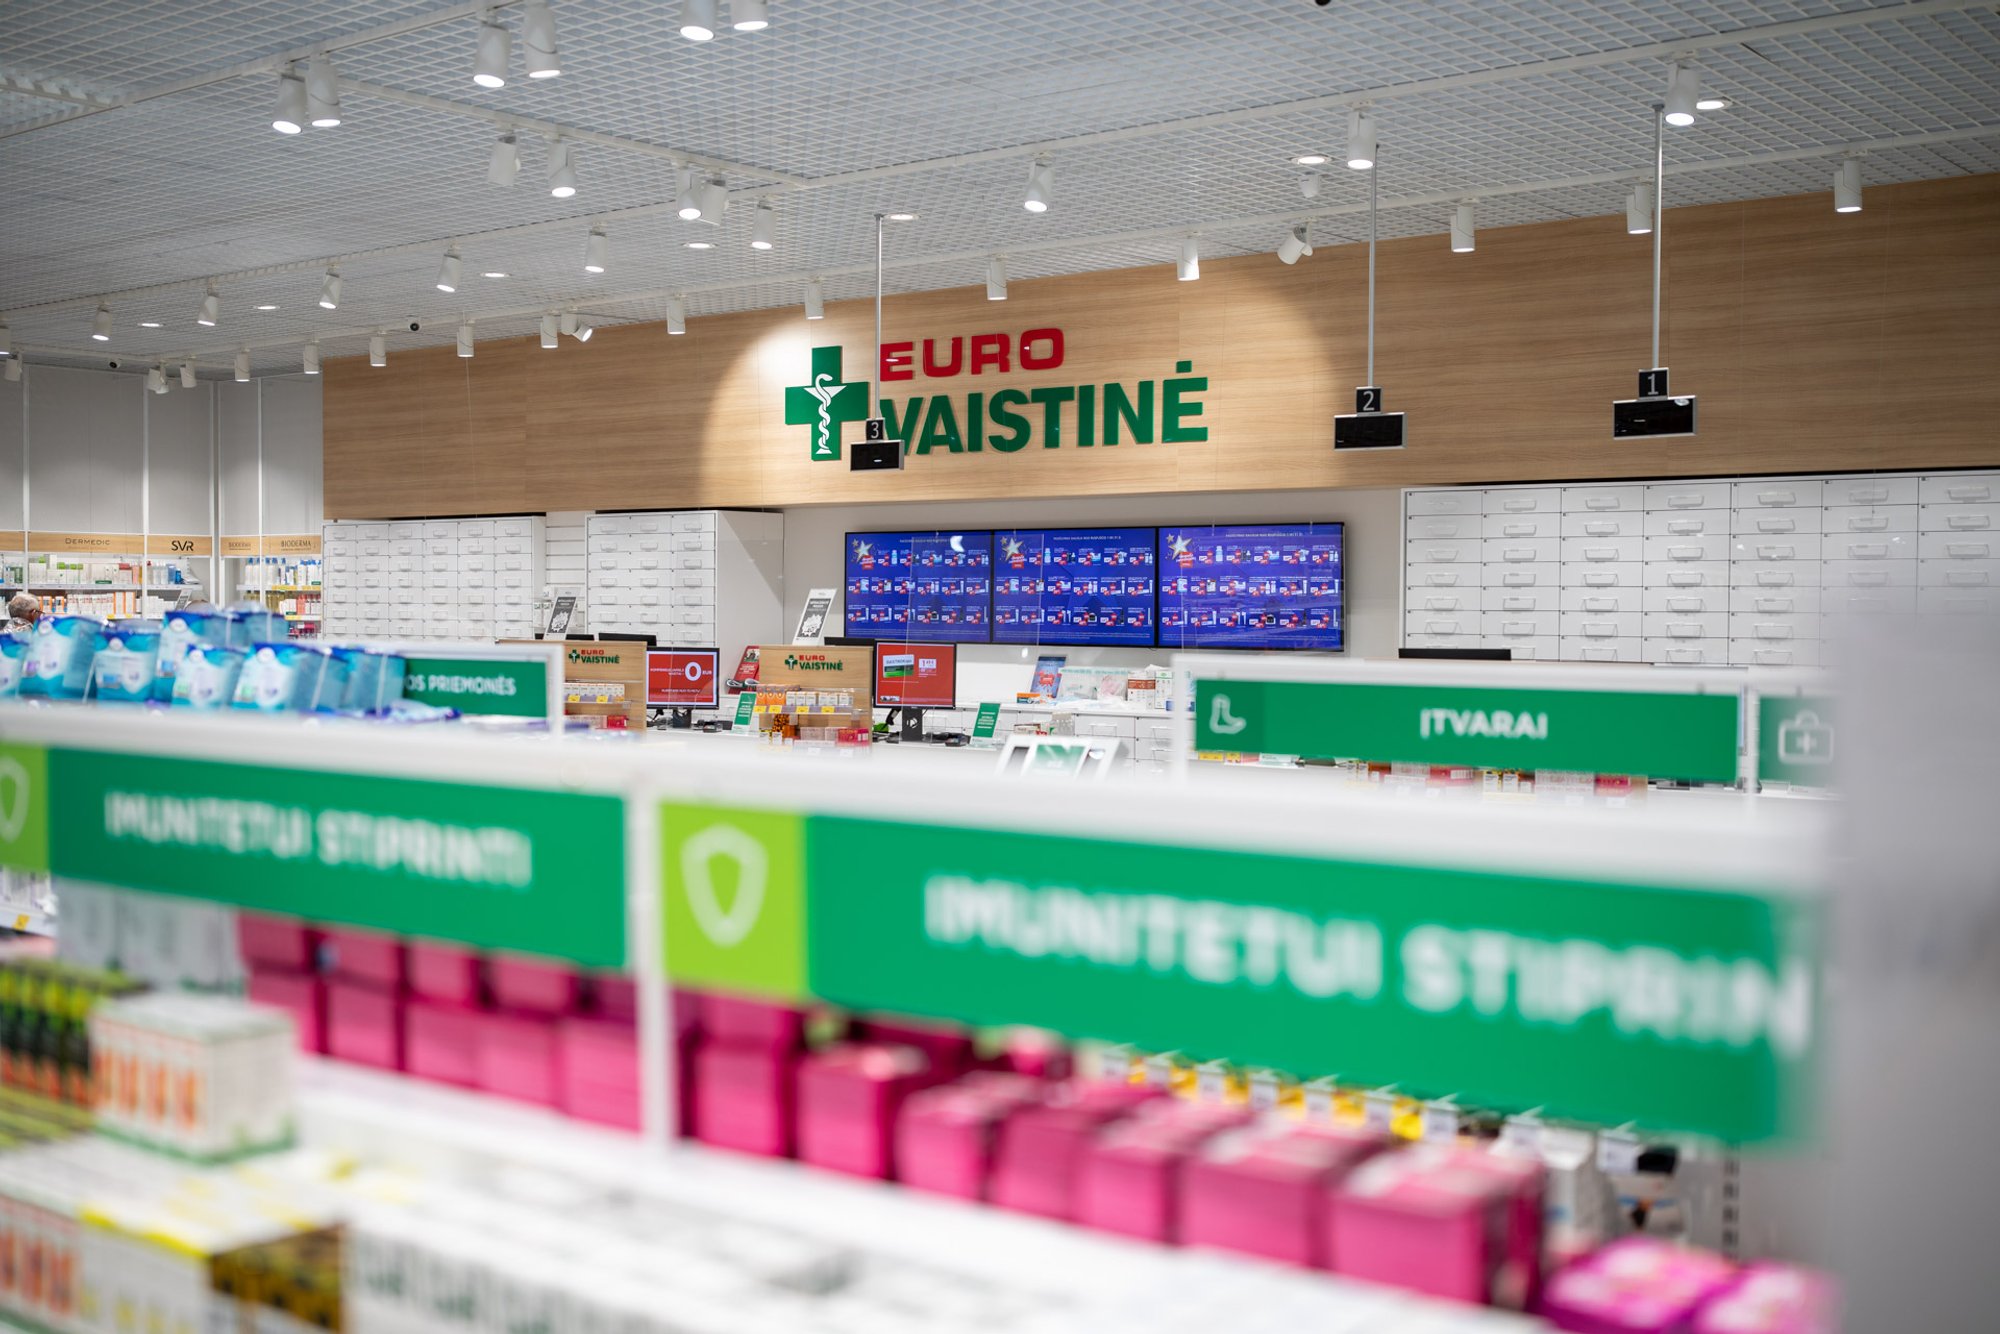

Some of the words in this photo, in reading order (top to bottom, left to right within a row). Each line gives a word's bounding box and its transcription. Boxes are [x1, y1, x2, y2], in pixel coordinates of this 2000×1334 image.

[880, 328, 1064, 381] EURO
[1647, 373, 1659, 395] 1
[880, 360, 1208, 455] VAISTINĖ
[1362, 390, 1375, 411] 2
[870, 421, 880, 439] 3
[171, 540, 194, 551] SVR
[281, 539, 311, 547] BIODERMA
[581, 655, 620, 664] VAISTINĖ
[799, 660, 843, 671] VAISTINĖ
[403, 674, 426, 692] OS
[104, 790, 312, 860] IMUNITETUI
[316, 808, 533, 889] STIPRINTI
[924, 874, 1385, 1001] IMUNITETUI
